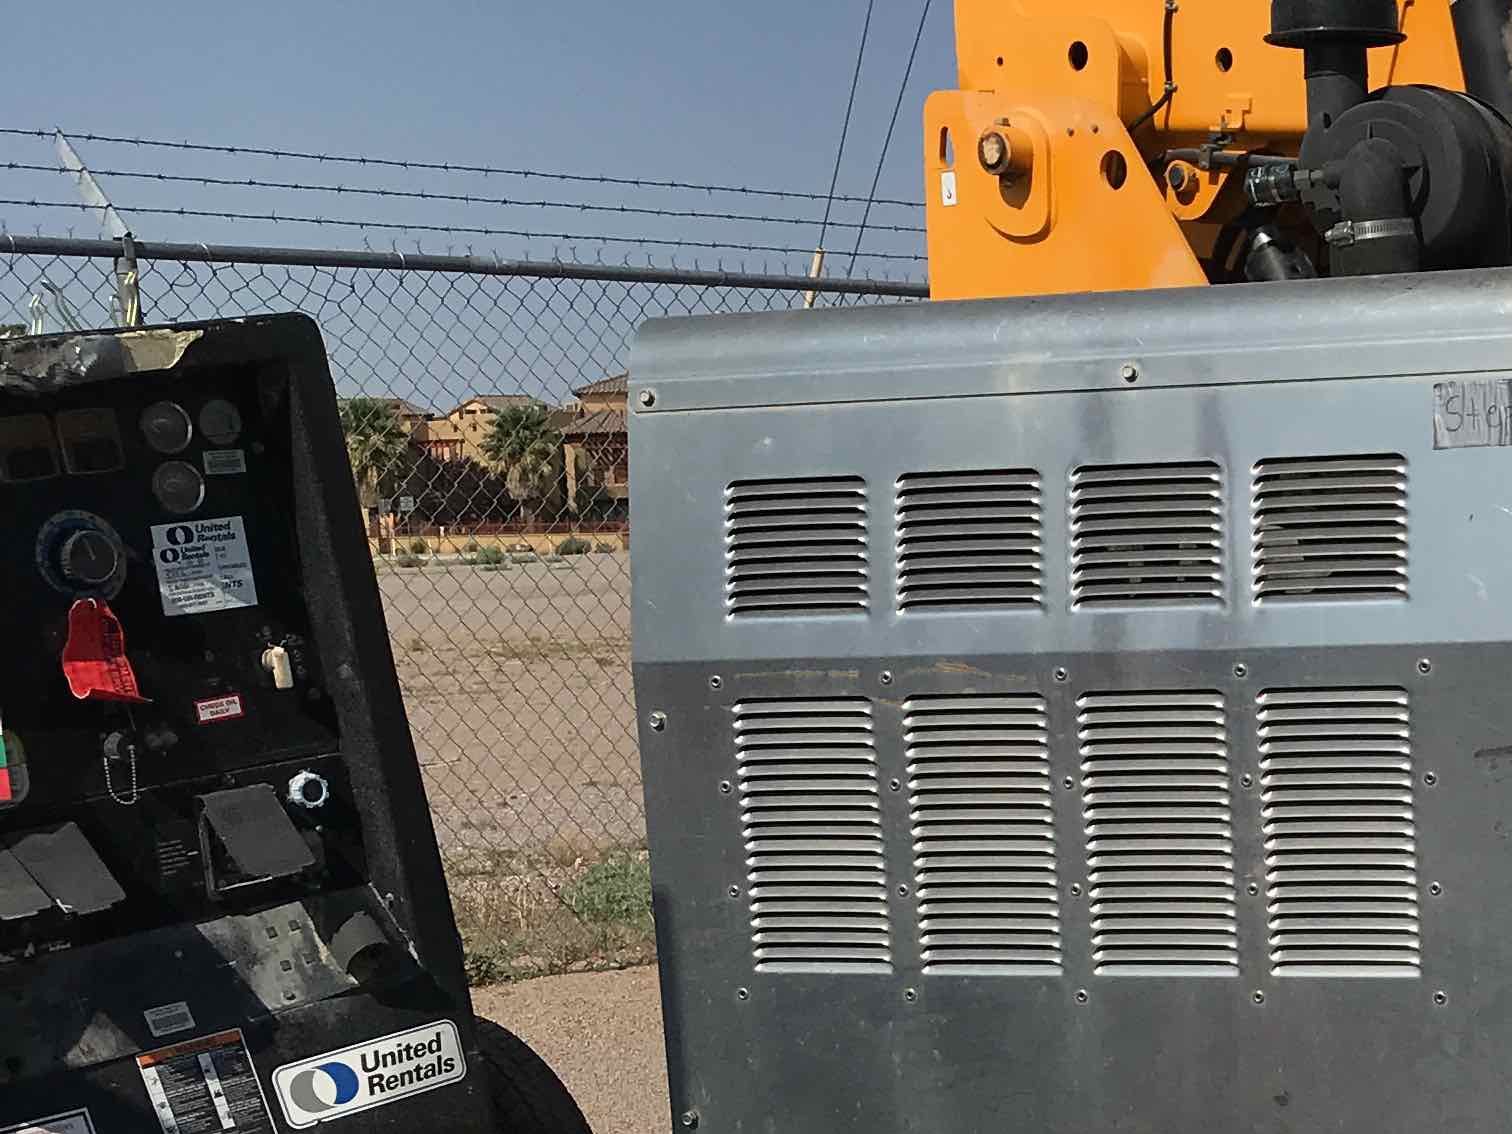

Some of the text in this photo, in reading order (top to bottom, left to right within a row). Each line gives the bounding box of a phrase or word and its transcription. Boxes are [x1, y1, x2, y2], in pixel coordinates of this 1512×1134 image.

[195, 520, 231, 534] United
[360, 1031, 443, 1074] United
[367, 1054, 456, 1097] Rentals
